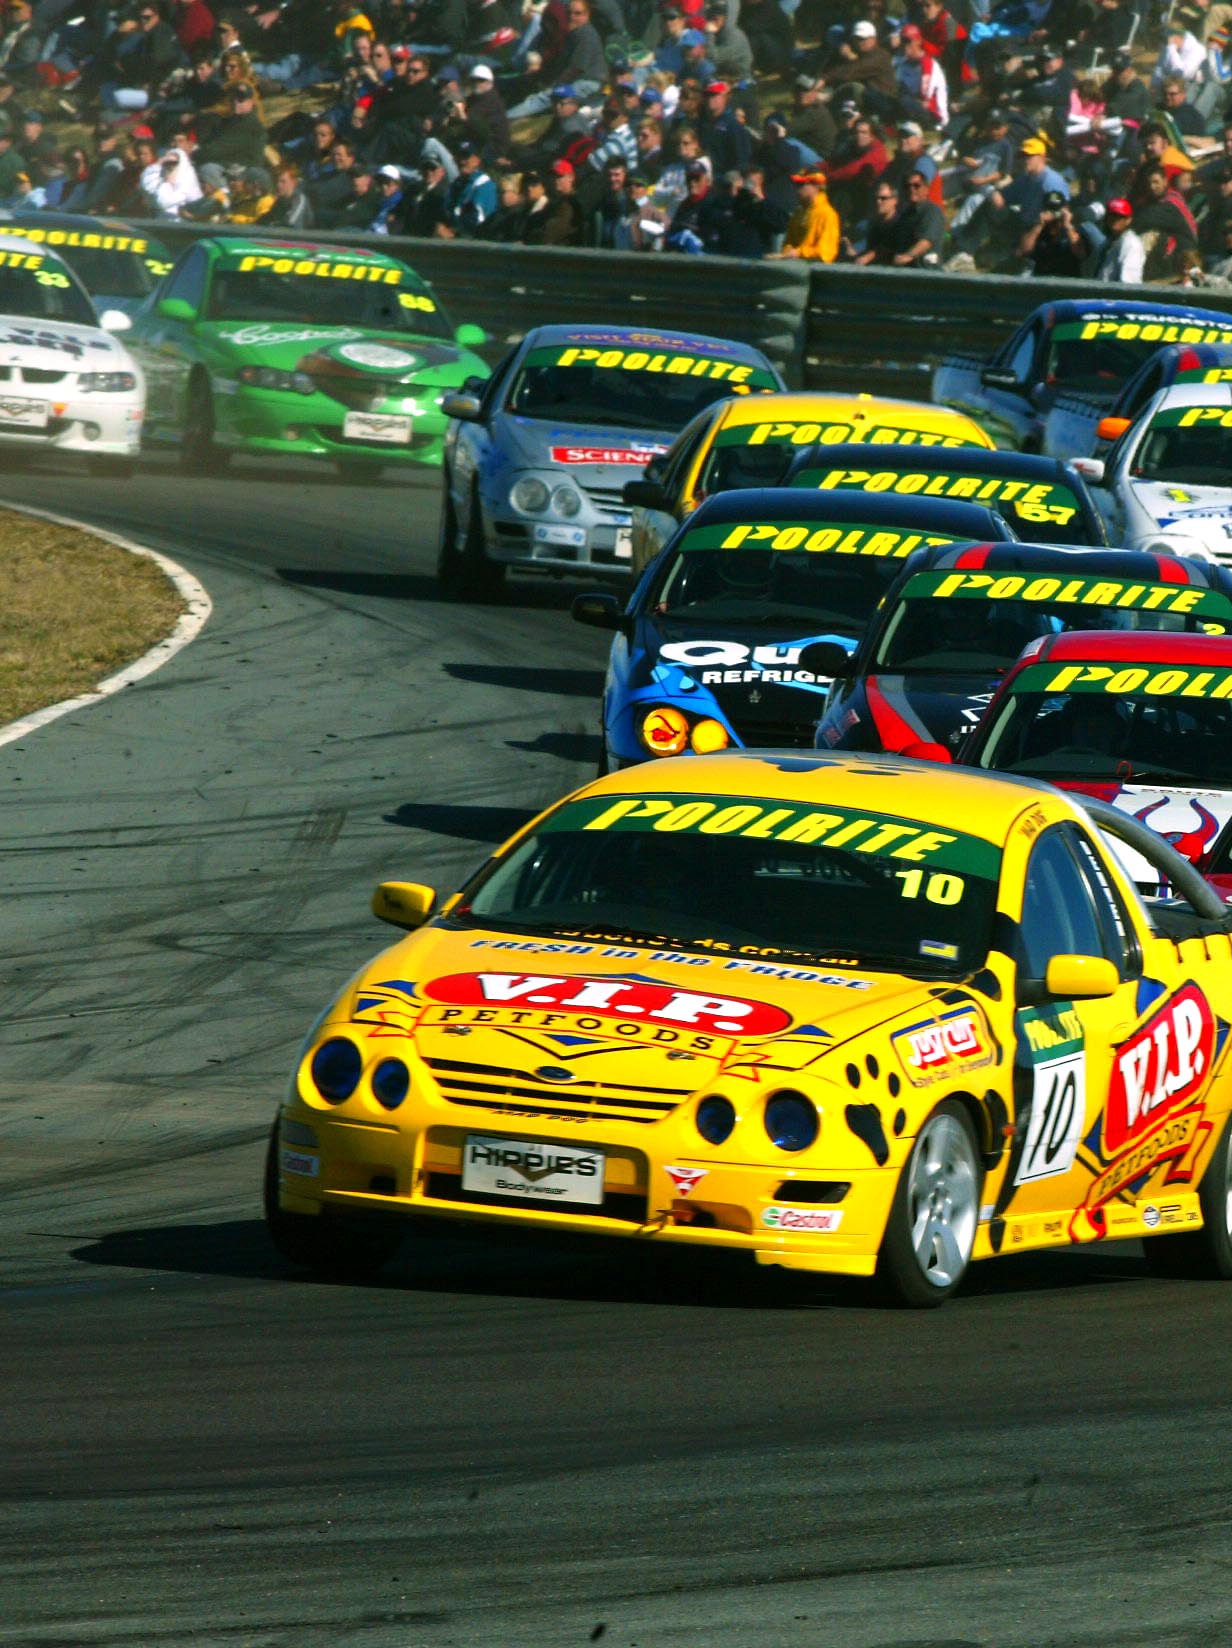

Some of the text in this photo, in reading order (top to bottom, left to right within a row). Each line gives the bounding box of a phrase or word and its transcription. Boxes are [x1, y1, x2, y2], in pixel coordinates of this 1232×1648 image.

[239, 256, 403, 284] POOLRITE
[556, 348, 754, 382] POOLRITE
[818, 470, 1054, 505] POOLRITE
[1018, 502, 1076, 525] 57
[720, 525, 954, 558] POOLRI
[932, 574, 1205, 612] POOLRITE
[584, 799, 957, 861] POOLRITE
[895, 869, 965, 906] 10
[468, 938, 878, 992] FRESH in the FRIDGE
[438, 1007, 715, 1054] PETFOODS
[1026, 1070, 1078, 1171] 10
[470, 1144, 599, 1177] HIPPIES
[496, 1178, 568, 1197] Bodywear
[780, 1210, 835, 1230] Castrol
